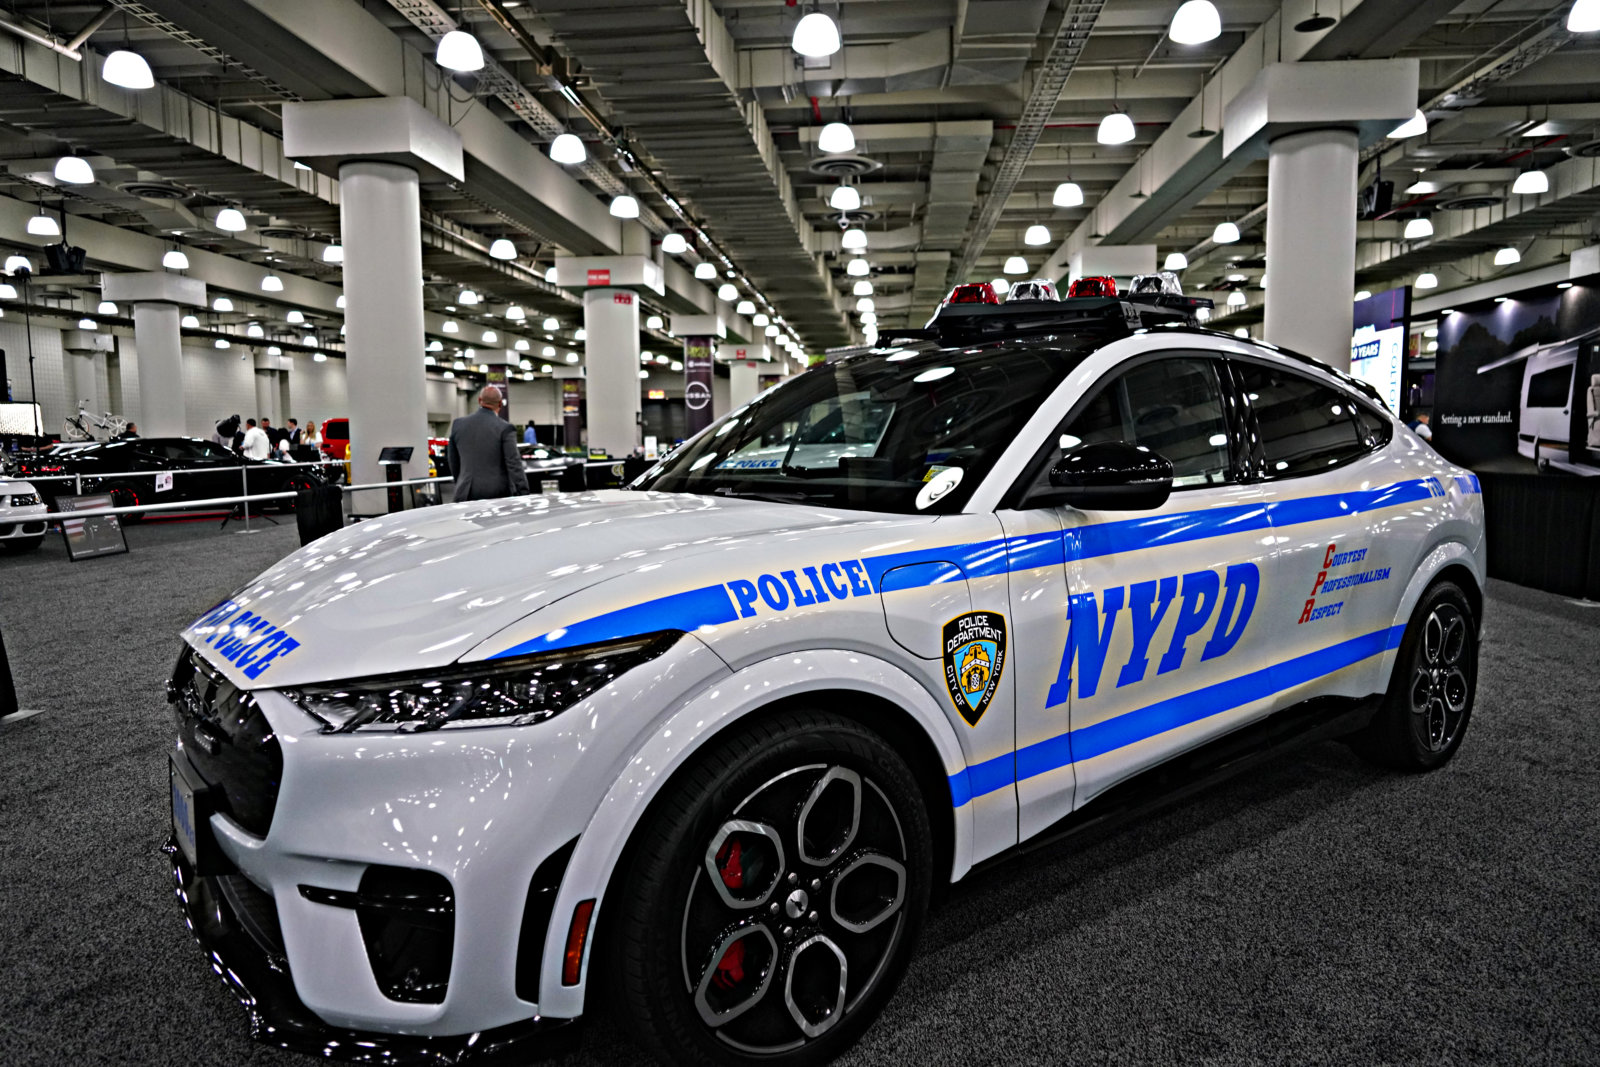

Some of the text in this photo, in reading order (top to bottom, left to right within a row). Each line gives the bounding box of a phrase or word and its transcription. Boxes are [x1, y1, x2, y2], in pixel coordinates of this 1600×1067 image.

[1358, 343, 1379, 358] YEARS
[1441, 410, 1513, 428] Setting a new standard.
[1323, 544, 1368, 569] COURTESY
[726, 559, 872, 618] POLICE
[1310, 567, 1392, 596] PROFESSIONALISM
[958, 615, 989, 631] POLICE
[1298, 598, 1344, 625] RESPECT
[205, 610, 301, 681] POLICE
[947, 627, 1002, 653] DEPARTMENT
[1045, 562, 1260, 709] NYPD
[946, 665, 966, 706] CITY OF
[982, 650, 1004, 705] NEW YORK
